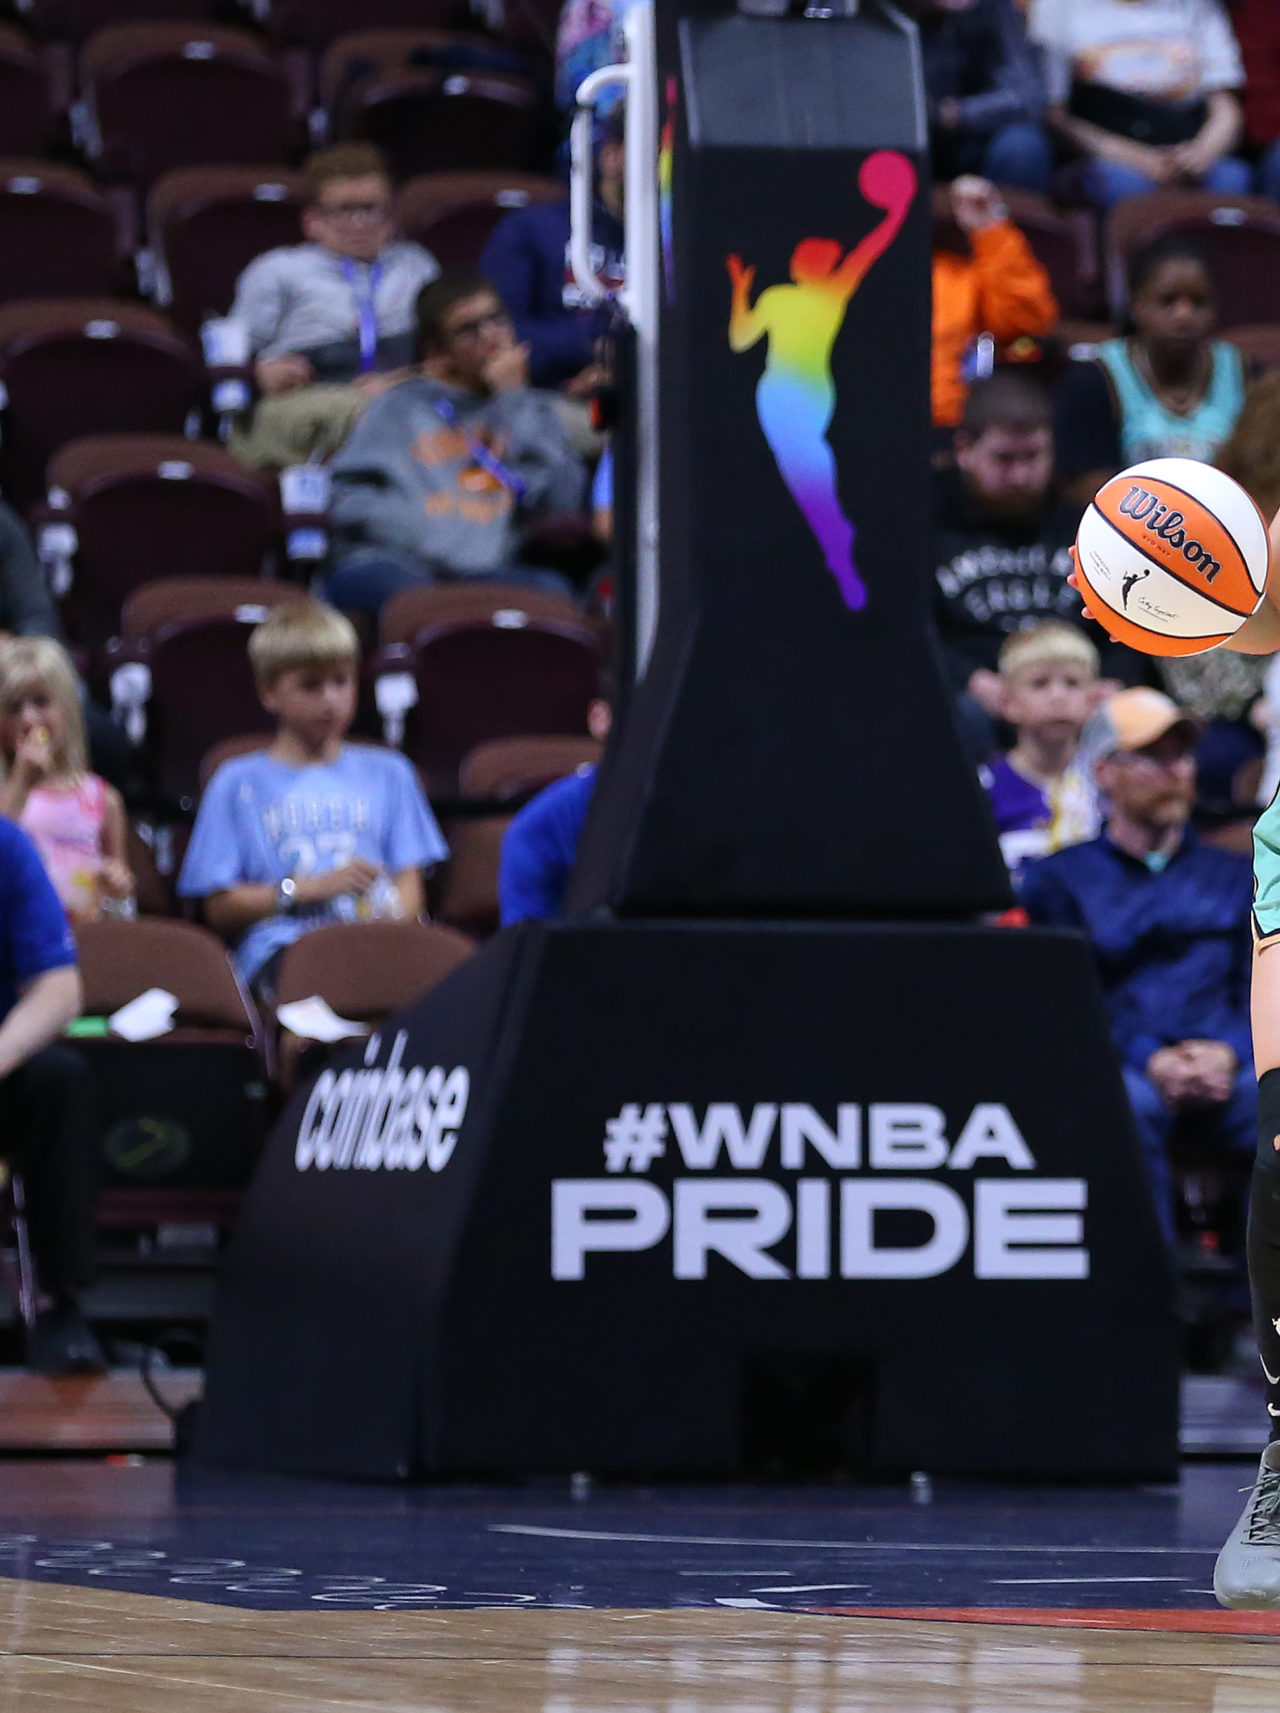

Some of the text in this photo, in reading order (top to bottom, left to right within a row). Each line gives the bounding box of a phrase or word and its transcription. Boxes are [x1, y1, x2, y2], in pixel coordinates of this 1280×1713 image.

[1119, 486, 1221, 585] Wilson
[295, 1028, 470, 1172] coinbase
[603, 1102, 1037, 1172] #WNBA
[551, 1177, 1090, 1280] PRIDE
